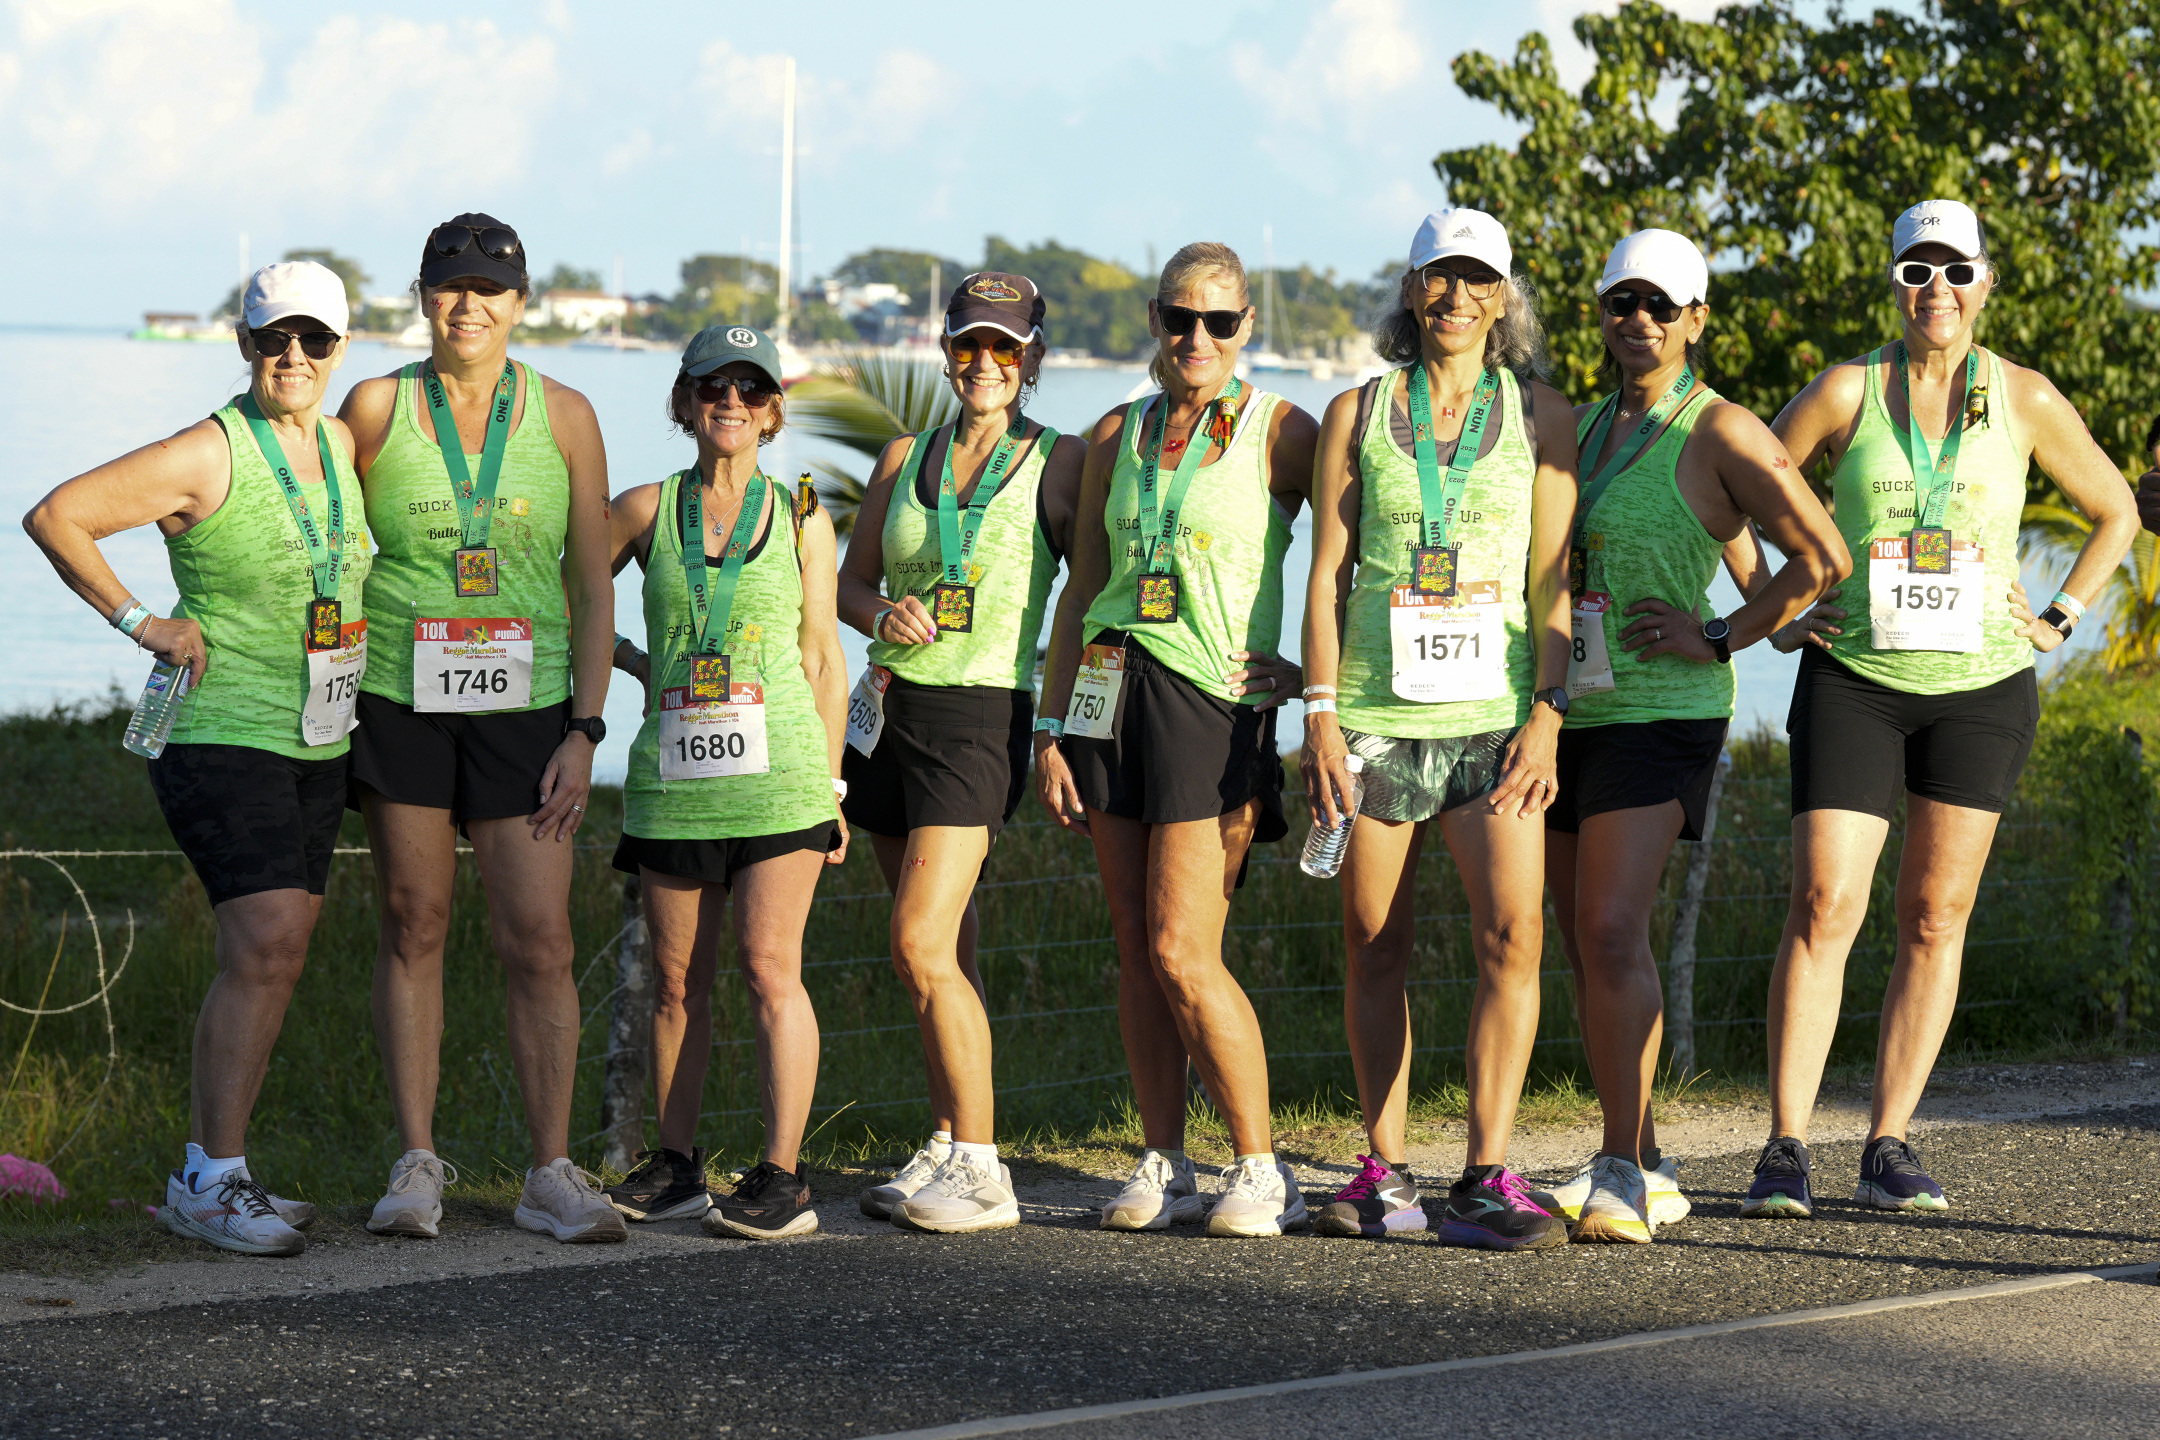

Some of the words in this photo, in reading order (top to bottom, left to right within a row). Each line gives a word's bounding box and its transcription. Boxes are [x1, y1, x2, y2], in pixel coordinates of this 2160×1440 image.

[1922, 216, 1940, 226] OR
[429, 382, 444, 409] RUN
[1640, 412, 1662, 435] ONE
[1672, 372, 1690, 395] RUN
[495, 398, 509, 423] ONE
[1011, 412, 1025, 433] ONE
[1469, 407, 1484, 434] RUN
[1152, 417, 1163, 440] ONE
[990, 452, 1008, 475] RUN
[1144, 465, 1154, 492] RUN
[1873, 481, 1914, 493] SUCK
[278, 467, 297, 494] ONE
[302, 519, 320, 548] RUN
[331, 499, 340, 528] RUN
[408, 499, 452, 515] SUCK
[688, 504, 698, 528] RUN
[1142, 505, 1156, 513] 2023
[1444, 497, 1456, 525] ONE
[1461, 511, 1482, 524] UP
[1162, 509, 1175, 538] RUN
[1429, 521, 1442, 547] RUN
[960, 530, 974, 556] ONE
[1876, 541, 1903, 558] 10K
[328, 554, 339, 582] ONE
[896, 562, 926, 574] SUCK
[693, 583, 707, 613] ONE
[1891, 584, 1961, 611] 1597
[421, 622, 448, 640] 10K
[495, 630, 521, 640] PUMA
[1414, 632, 1480, 661] 1571
[438, 668, 508, 695] 1746
[665, 690, 683, 709] 10K
[848, 697, 877, 735] 1509
[676, 732, 745, 762] 1680
